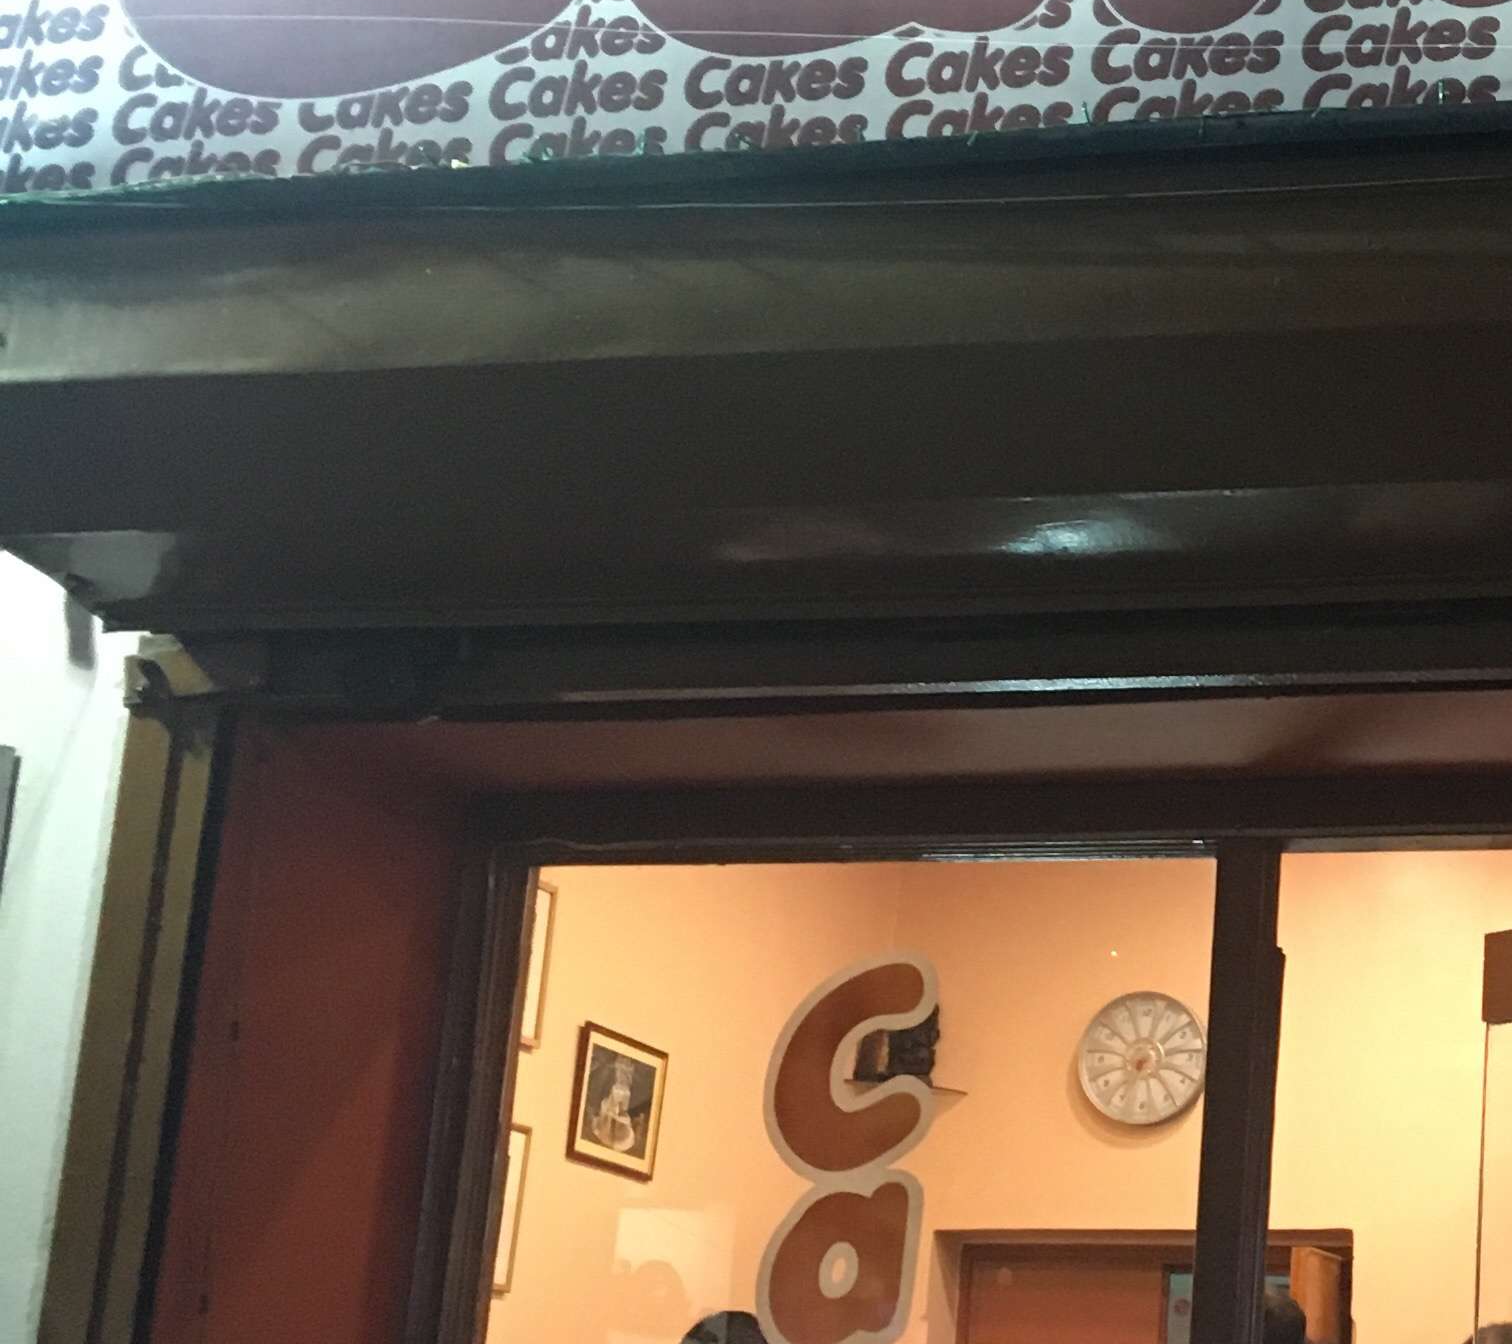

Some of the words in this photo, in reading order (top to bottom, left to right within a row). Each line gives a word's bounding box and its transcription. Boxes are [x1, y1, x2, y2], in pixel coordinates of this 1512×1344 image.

[488, 60, 667, 121] Cakes
[684, 56, 867, 109] Cakes
[884, 36, 1073, 97] Cakes
[1091, 27, 1283, 84] Cakes
[1301, 6, 1499, 72] Cakes
